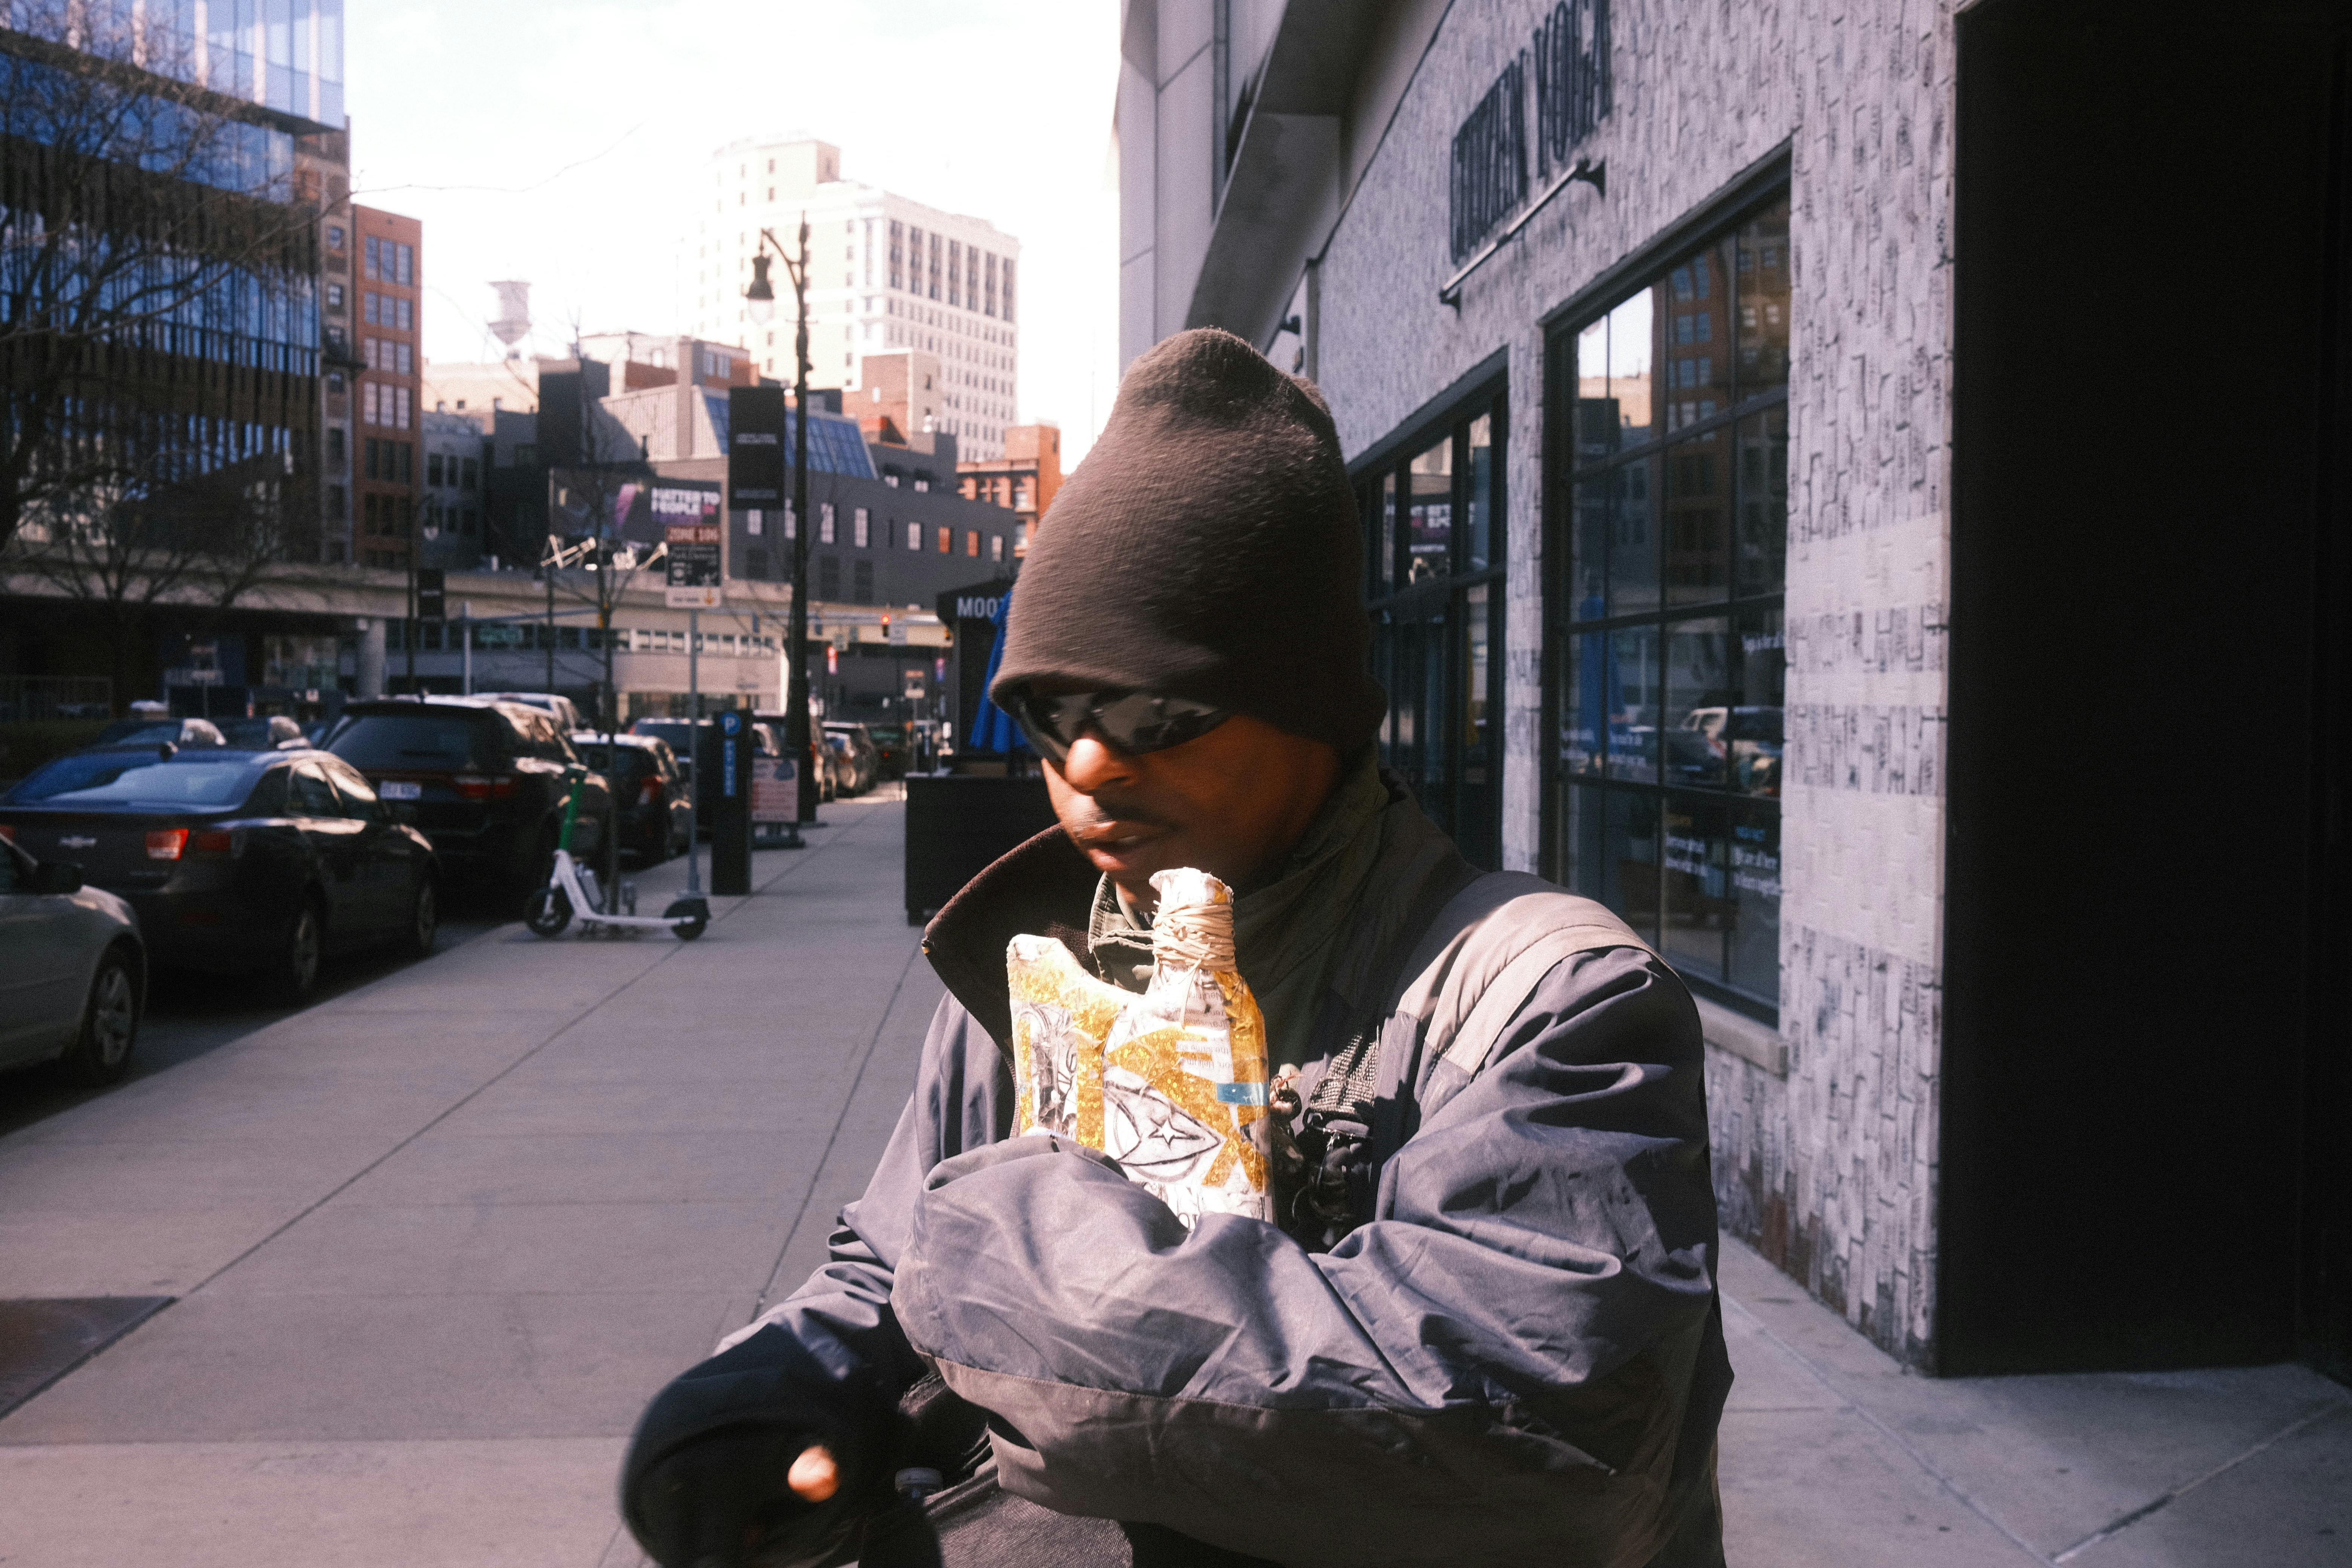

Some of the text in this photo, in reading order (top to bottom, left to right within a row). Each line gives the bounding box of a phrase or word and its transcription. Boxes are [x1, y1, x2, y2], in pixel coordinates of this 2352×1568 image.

[703, 491, 720, 505] TO
[651, 500, 700, 515] PEOPLE
[667, 527, 695, 541] ZONE
[957, 596, 1003, 619] MOO
[724, 717, 736, 733] P
